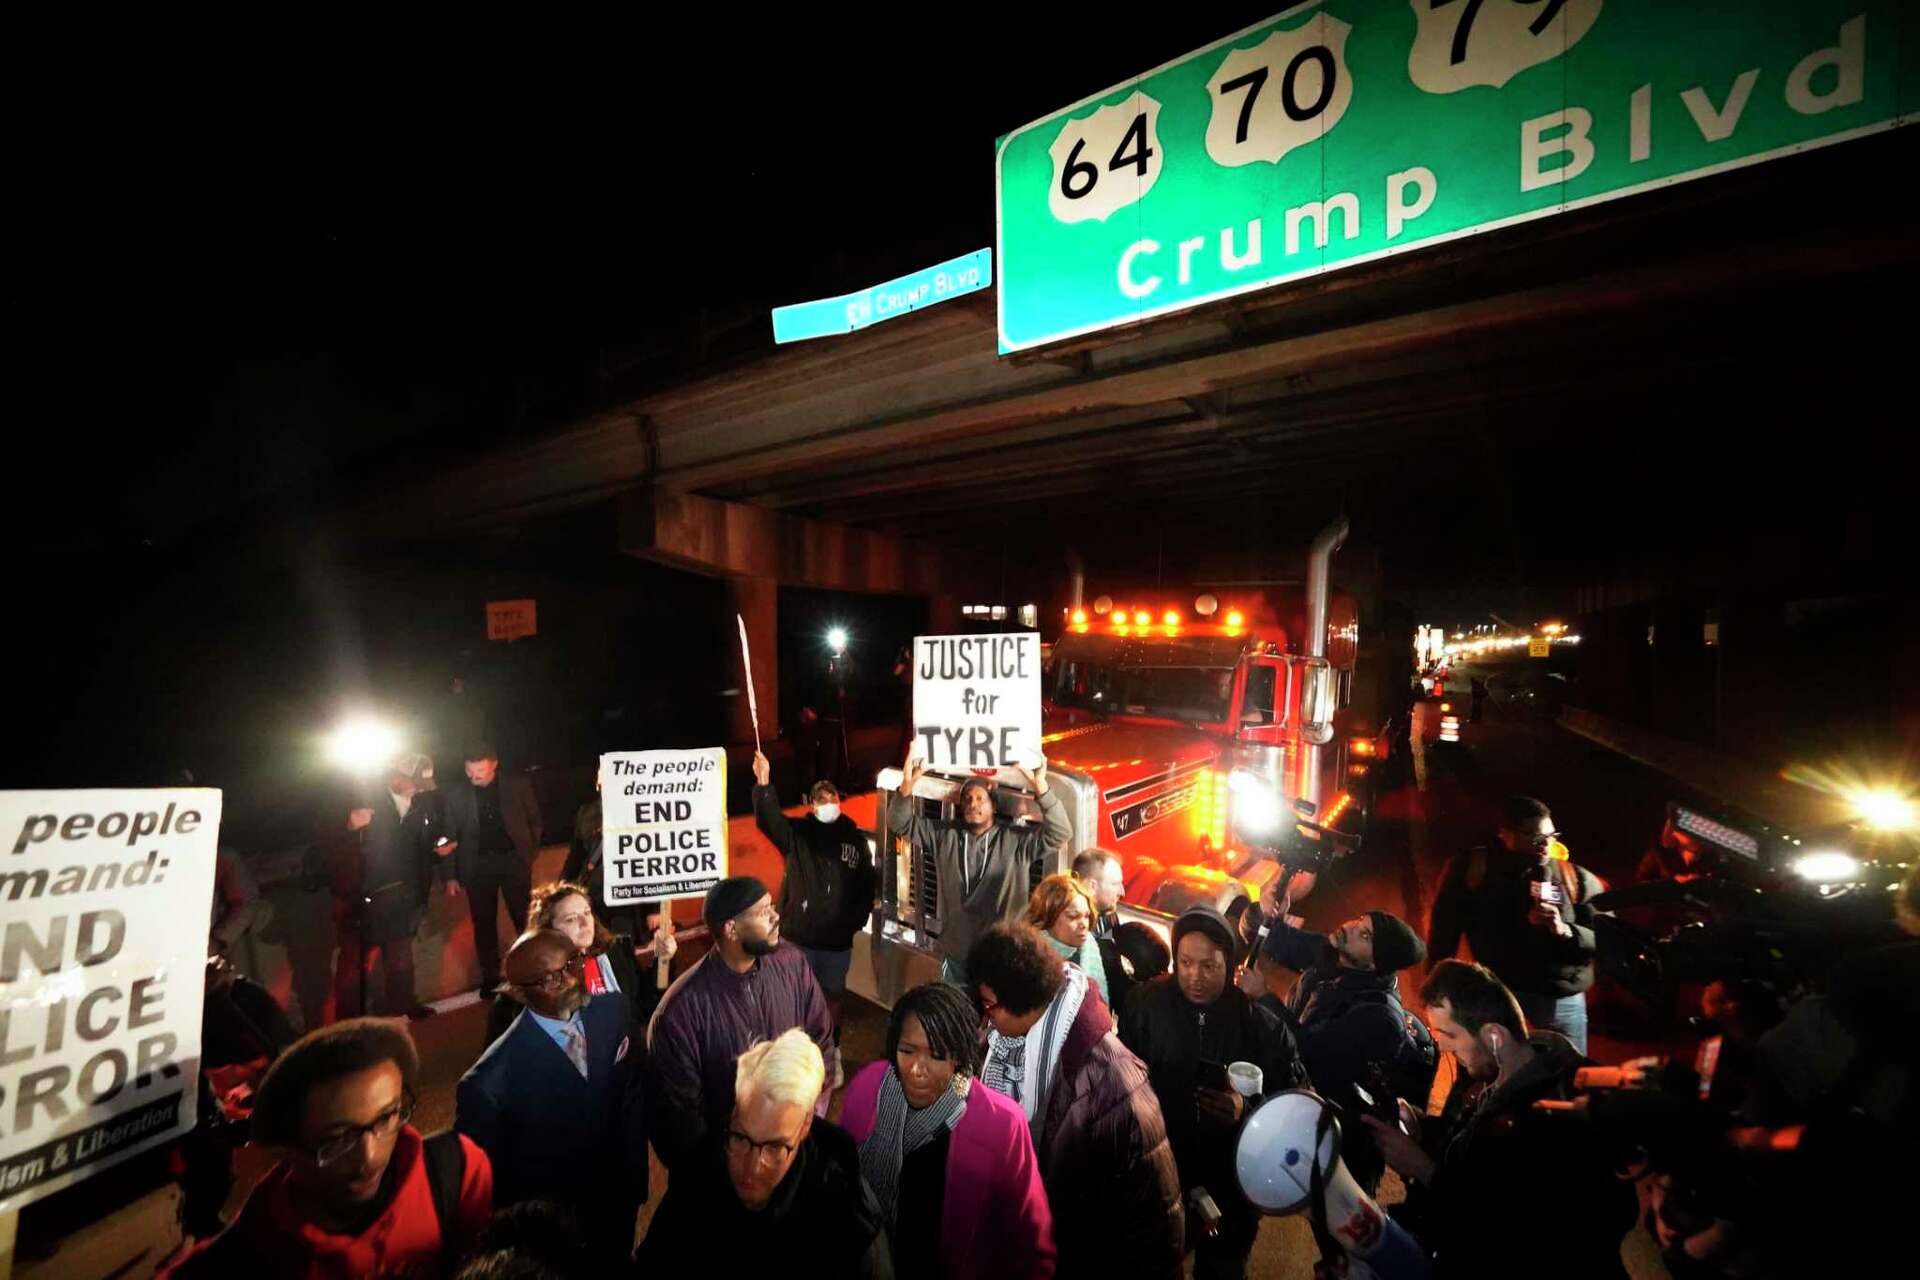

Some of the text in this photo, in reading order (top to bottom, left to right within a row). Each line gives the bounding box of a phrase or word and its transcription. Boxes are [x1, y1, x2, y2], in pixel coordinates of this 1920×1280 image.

[1221, 45, 1336, 144] 70
[1061, 113, 1153, 199] 64
[1117, 14, 1867, 299] Crump Blvd
[921, 637, 1029, 680] JUSTICE
[962, 687, 999, 715] for
[613, 757, 715, 777] The people
[918, 726, 1020, 766] TYRE
[624, 778, 703, 796] demand:
[11, 802, 202, 855] people
[635, 801, 691, 823] END
[618, 829, 711, 855] POLICE
[0, 851, 170, 900] mand:
[613, 853, 717, 878] TERROR
[613, 887, 632, 898] Party
[644, 881, 677, 894] Socialism
[0, 909, 126, 983] ND
[0, 974, 167, 1066] LICE
[0, 1032, 181, 1142] ROR
[51, 1143, 69, 1167] &
[75, 1104, 174, 1161] Liberation
